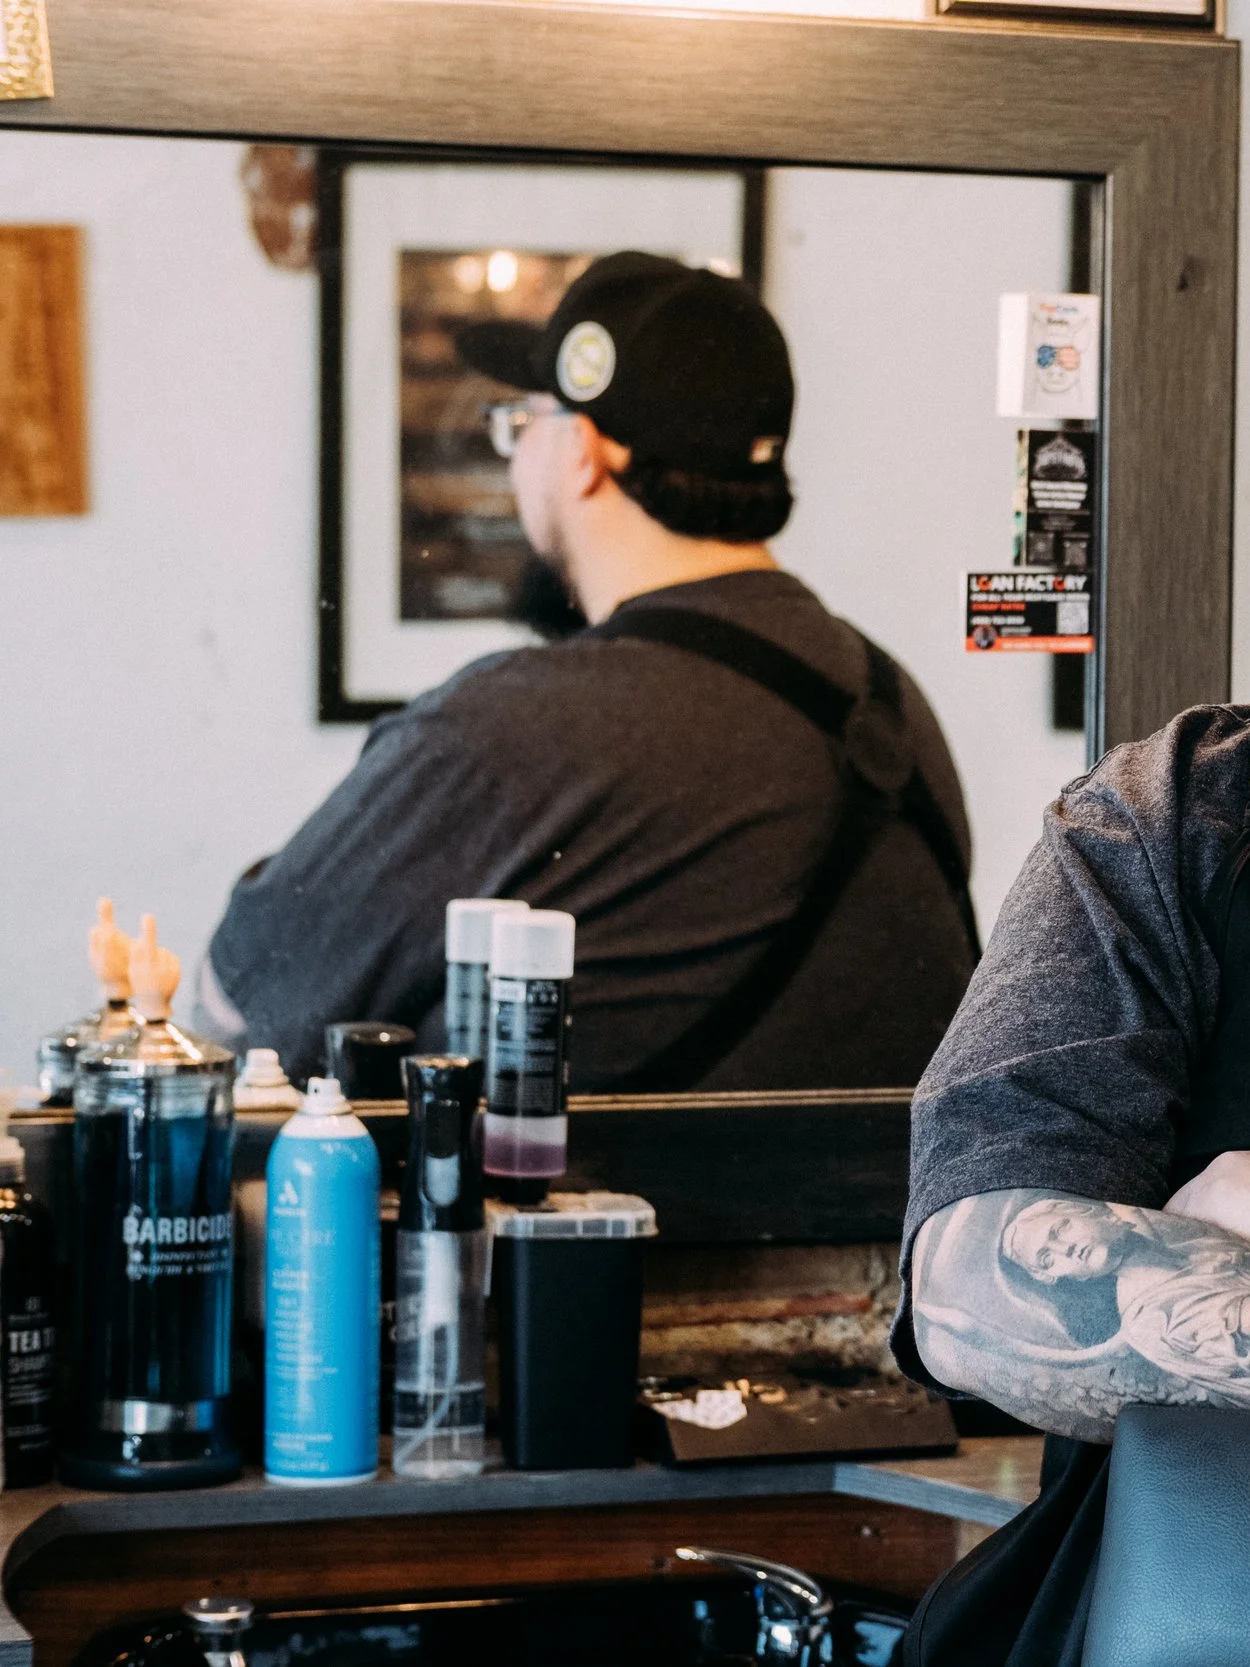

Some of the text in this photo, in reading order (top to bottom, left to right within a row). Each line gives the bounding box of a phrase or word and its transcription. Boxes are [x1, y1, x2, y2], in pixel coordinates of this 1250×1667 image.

[969, 574, 1087, 592] LOAN FACTORY
[9, 1330, 41, 1353] TEA
